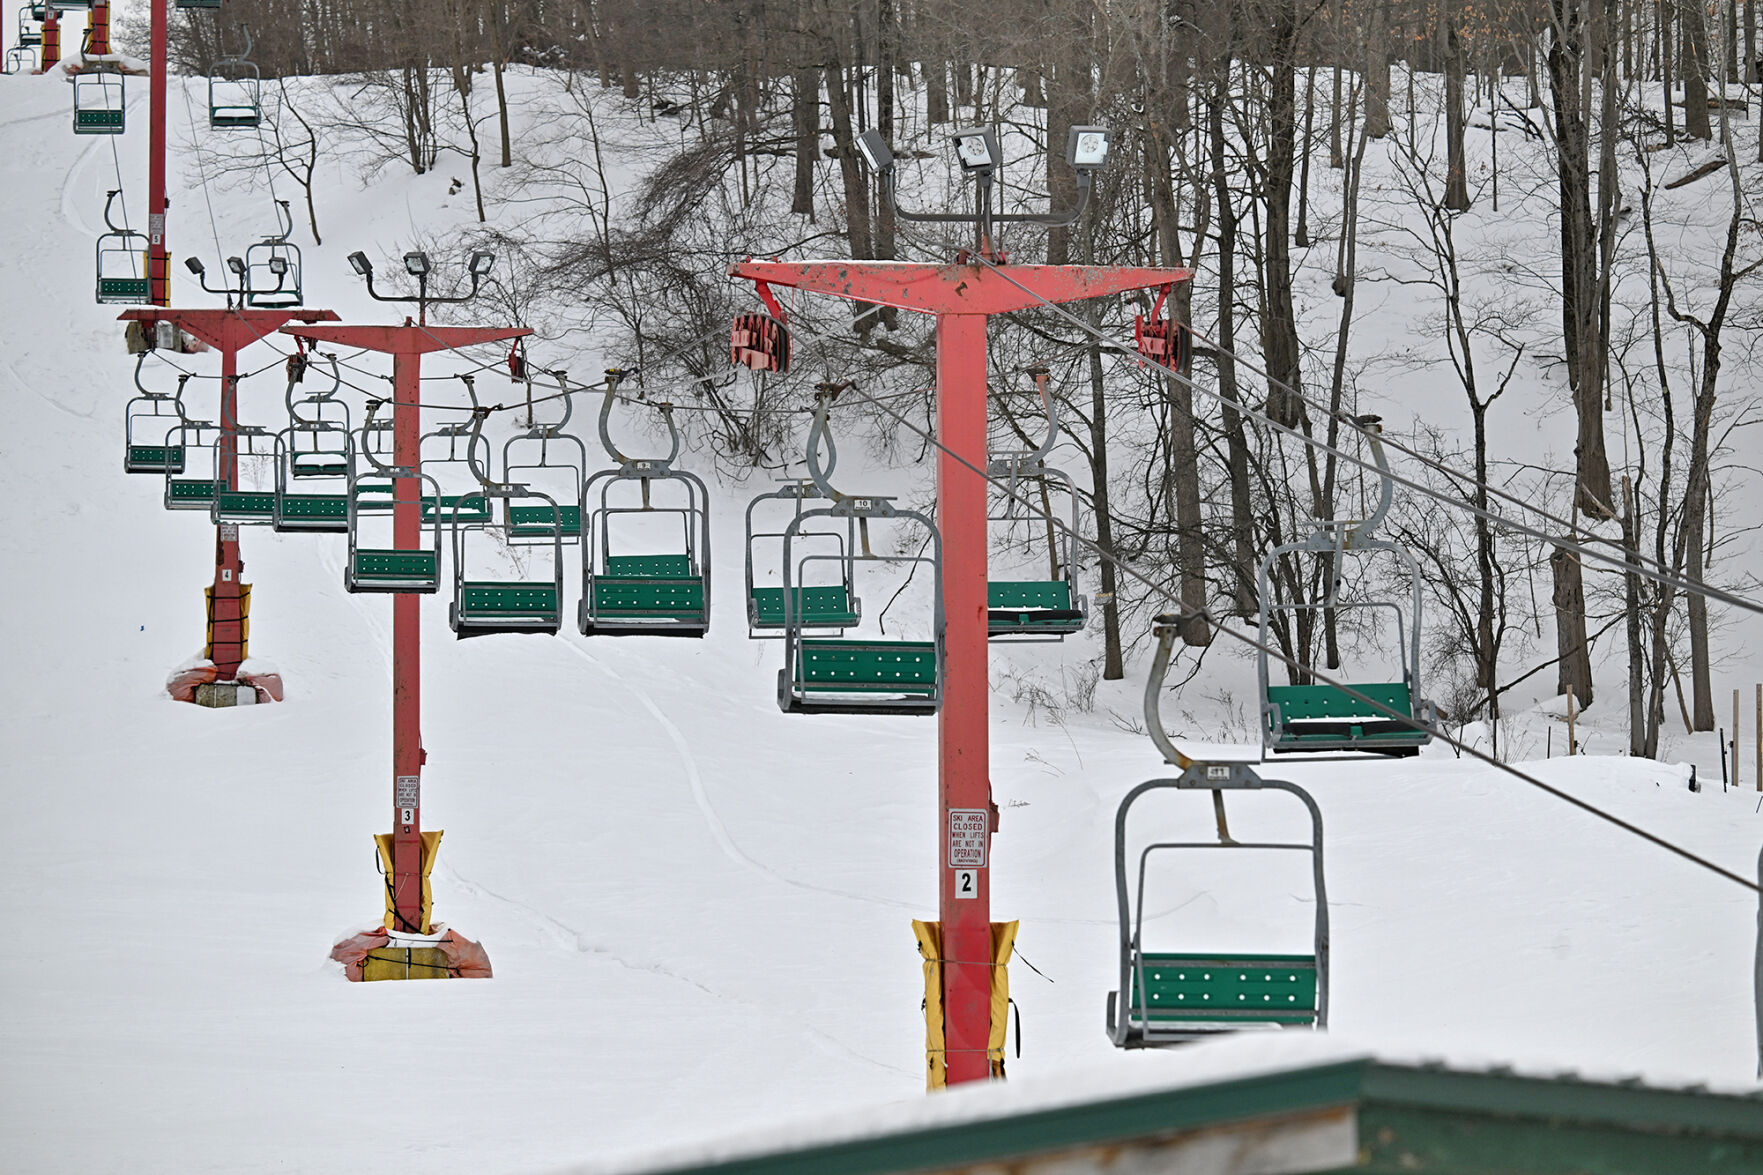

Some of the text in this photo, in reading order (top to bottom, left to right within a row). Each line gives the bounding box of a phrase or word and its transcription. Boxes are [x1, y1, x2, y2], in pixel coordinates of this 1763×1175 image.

[404, 810, 411, 821] 3
[954, 848, 981, 858] OPERATION
[962, 873, 971, 892] 2
